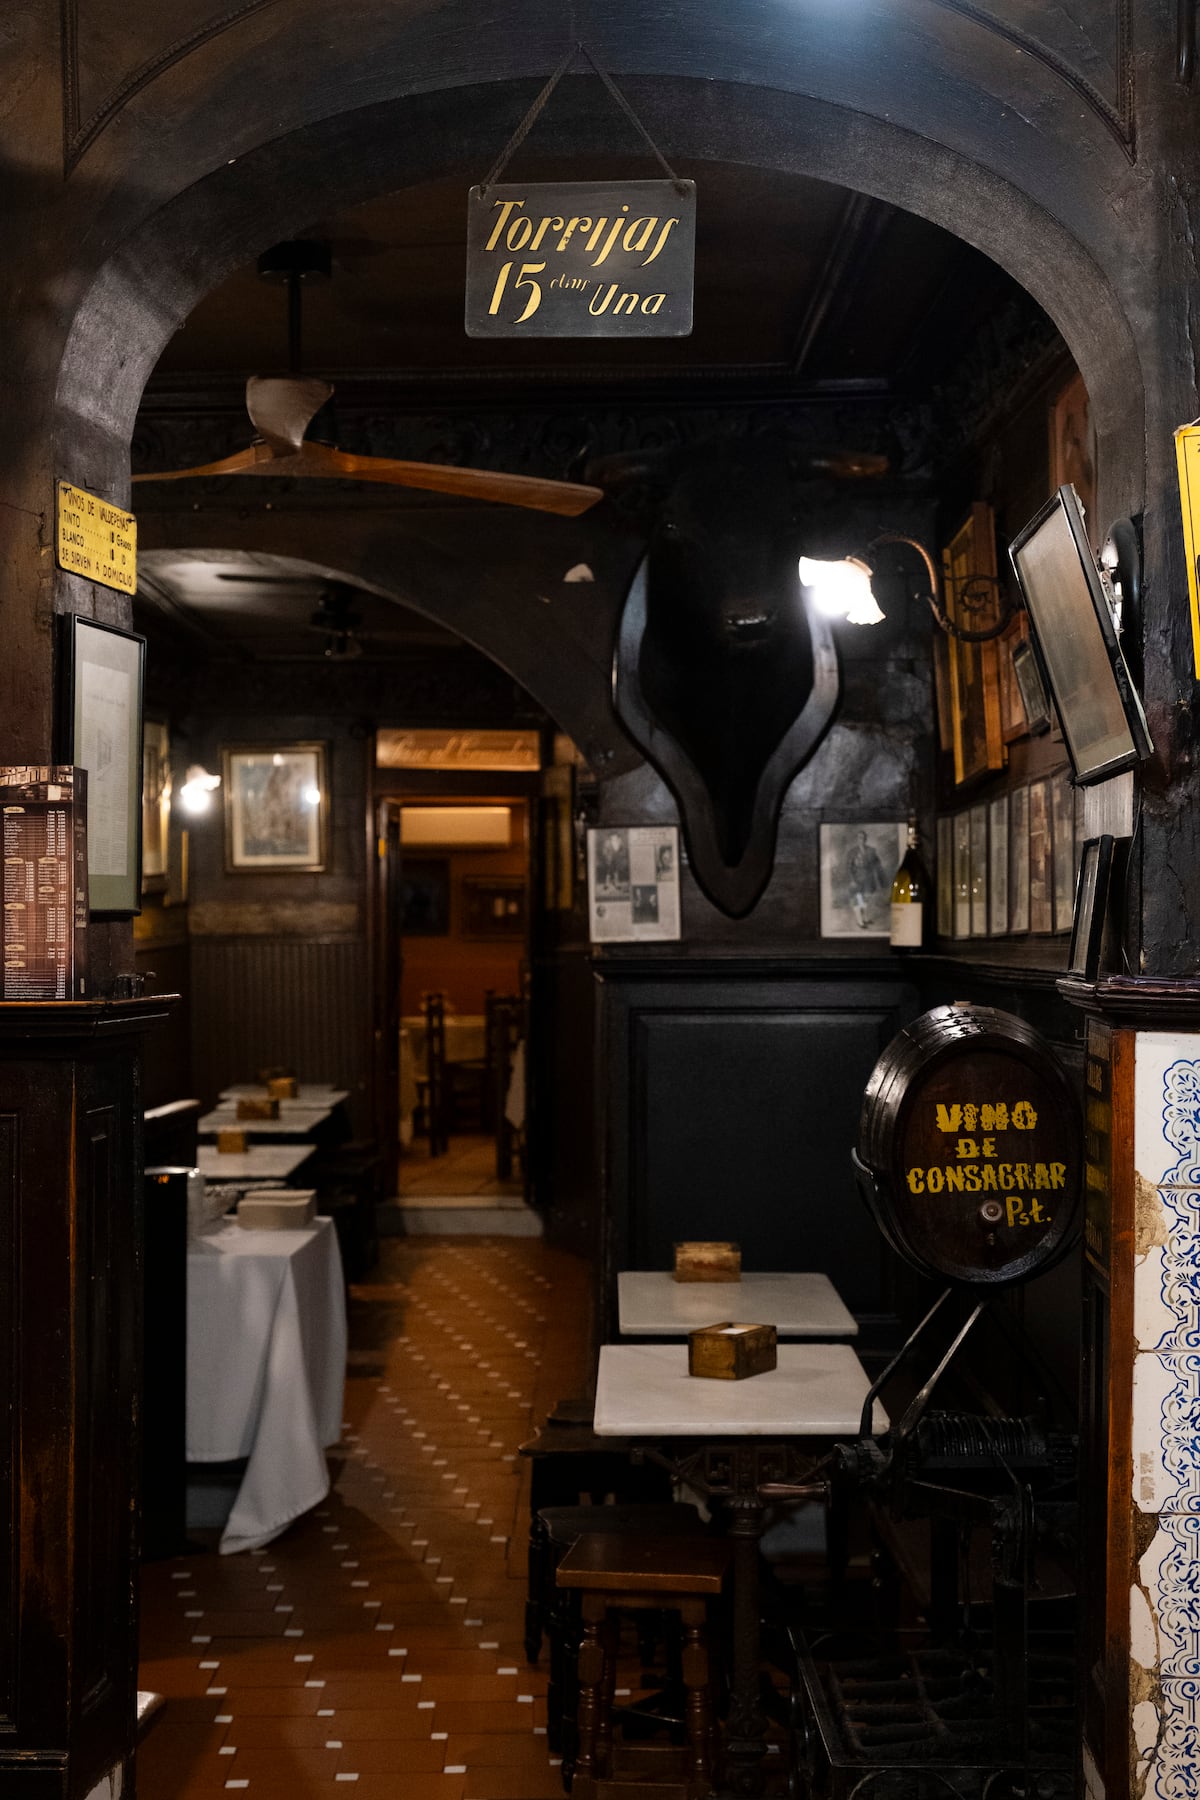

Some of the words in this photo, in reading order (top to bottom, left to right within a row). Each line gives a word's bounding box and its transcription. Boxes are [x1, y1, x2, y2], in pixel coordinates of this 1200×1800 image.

[484, 200, 679, 267] Torrijas
[488, 261, 546, 324] 15
[588, 284, 668, 316] Una
[63, 509, 80, 528] TINTO
[68, 491, 85, 512] VINOS
[88, 500, 94, 516] DE
[62, 528, 84, 547] BLANCO
[62, 548, 69, 561] SE
[71, 551, 91, 570] SIRVEN
[96, 561, 99, 575] A
[103, 565, 133, 587] DOMICILIO
[935, 1100, 1038, 1132] VINO
[954, 1137, 998, 1158] DE
[906, 1162, 1067, 1194] CONSAGRAR
[1005, 1196, 1052, 1227] Pst.
